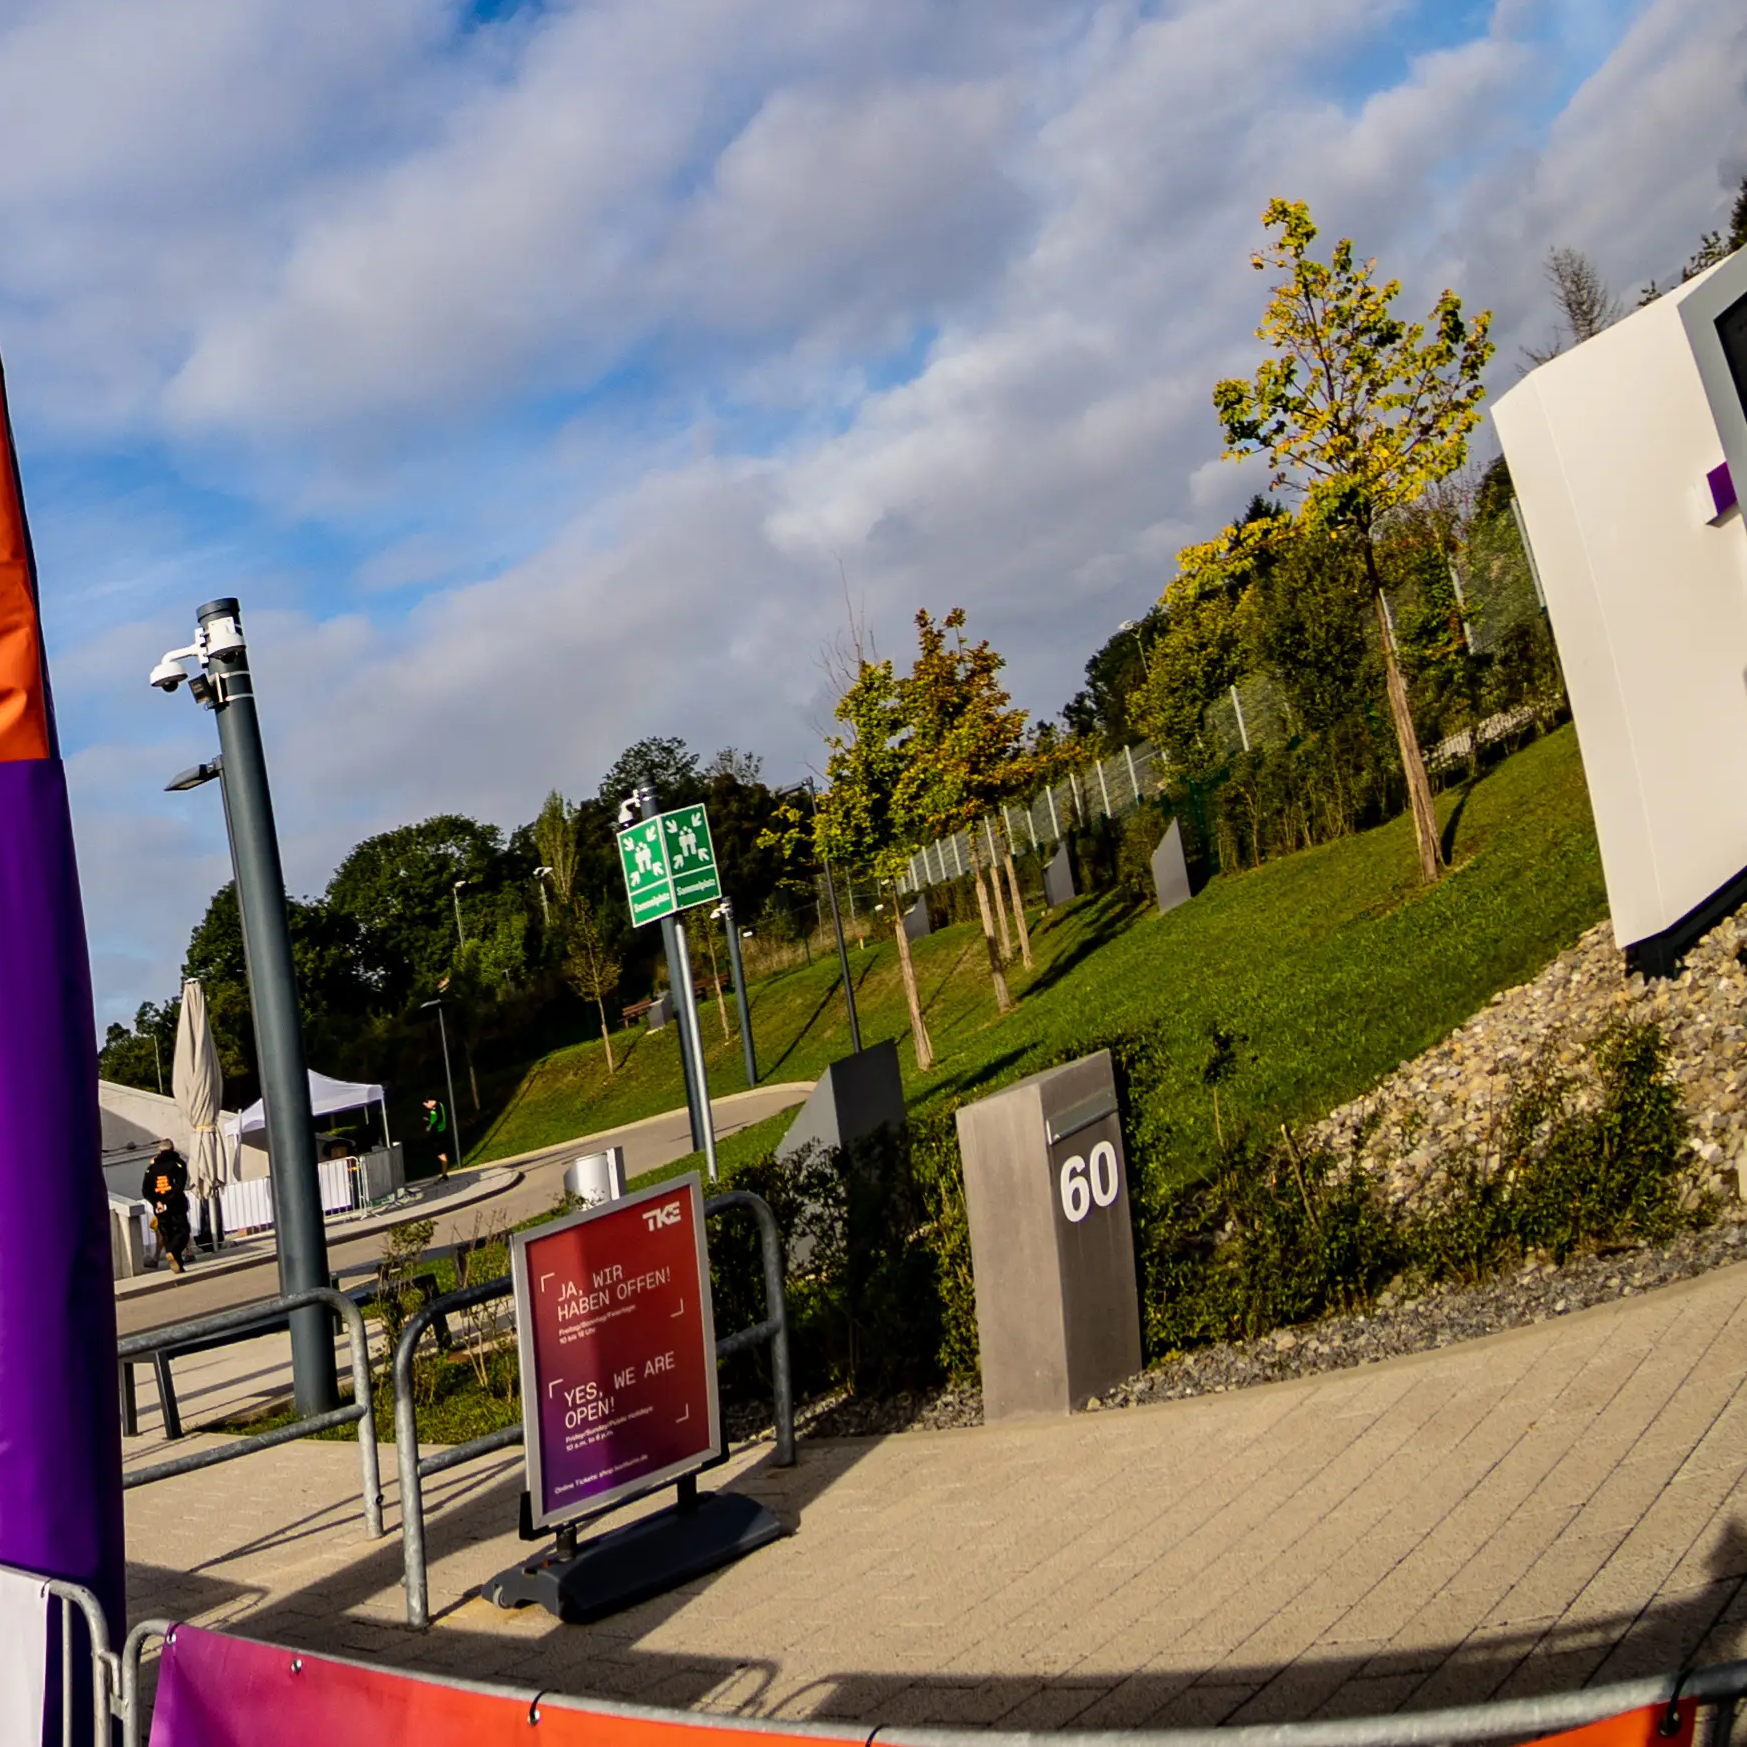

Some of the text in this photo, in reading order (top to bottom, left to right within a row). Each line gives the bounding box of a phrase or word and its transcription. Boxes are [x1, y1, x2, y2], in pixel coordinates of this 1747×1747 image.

[1060, 1140, 1119, 1223] 60
[642, 1201, 682, 1232] TKE
[558, 1265, 623, 1302] JA, WIR
[558, 1266, 671, 1322] HABEN OFFEN!
[564, 1351, 675, 1407] YES, WE ARE
[565, 1396, 615, 1429] OPEN!
